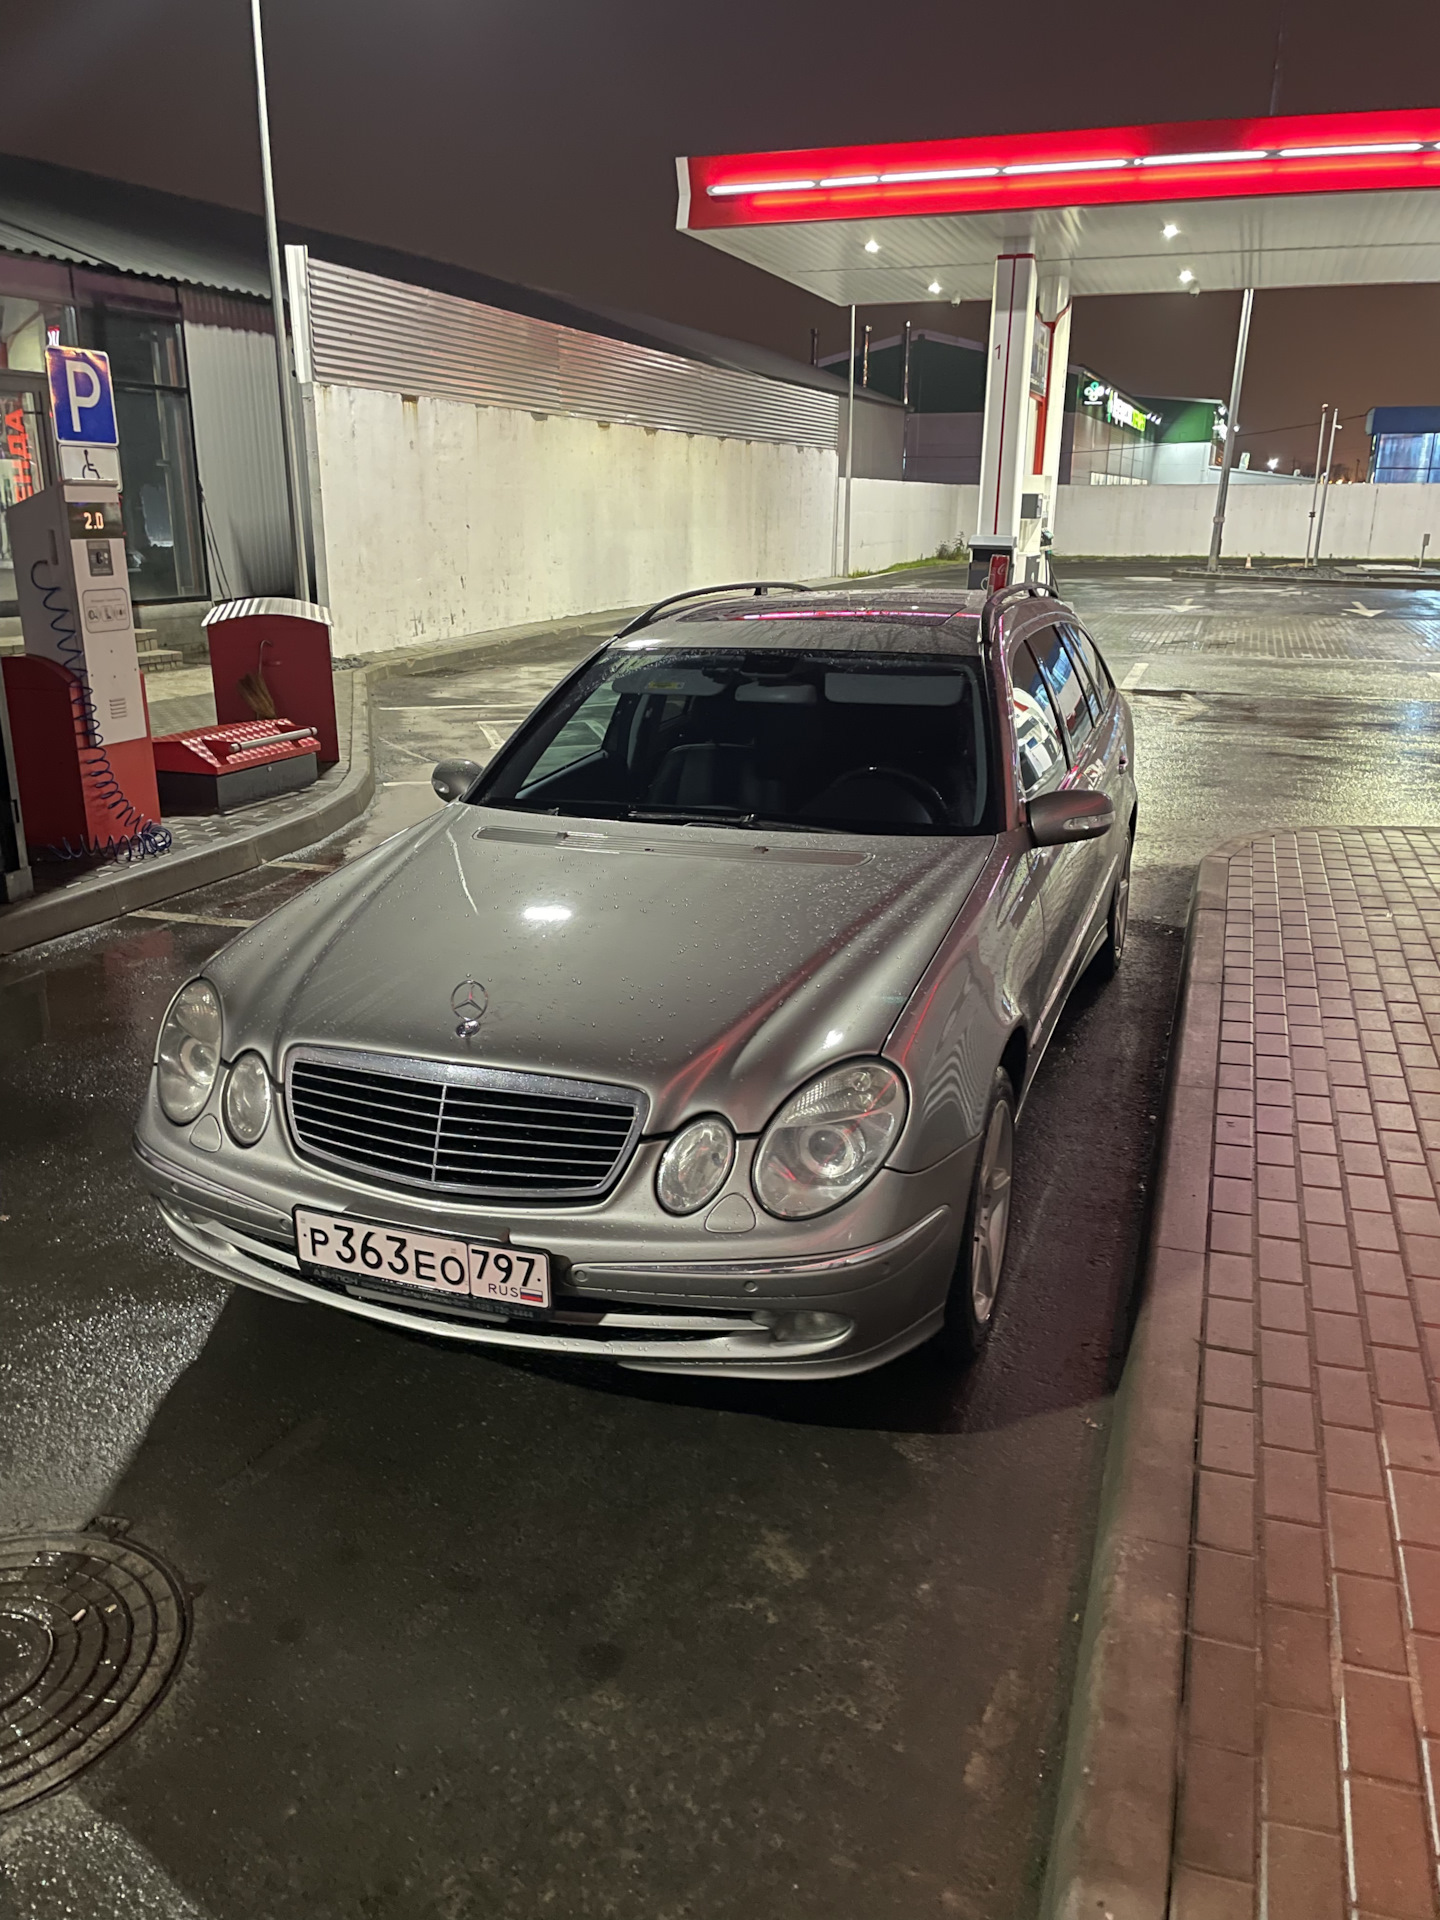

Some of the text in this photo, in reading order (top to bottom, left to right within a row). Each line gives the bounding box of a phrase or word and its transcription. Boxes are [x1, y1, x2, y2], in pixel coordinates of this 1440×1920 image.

[65, 359, 101, 433] P
[83, 511, 104, 530] 2.0
[309, 1224, 535, 1287] Р363ЕО 797
[488, 1282, 519, 1298] RUS
